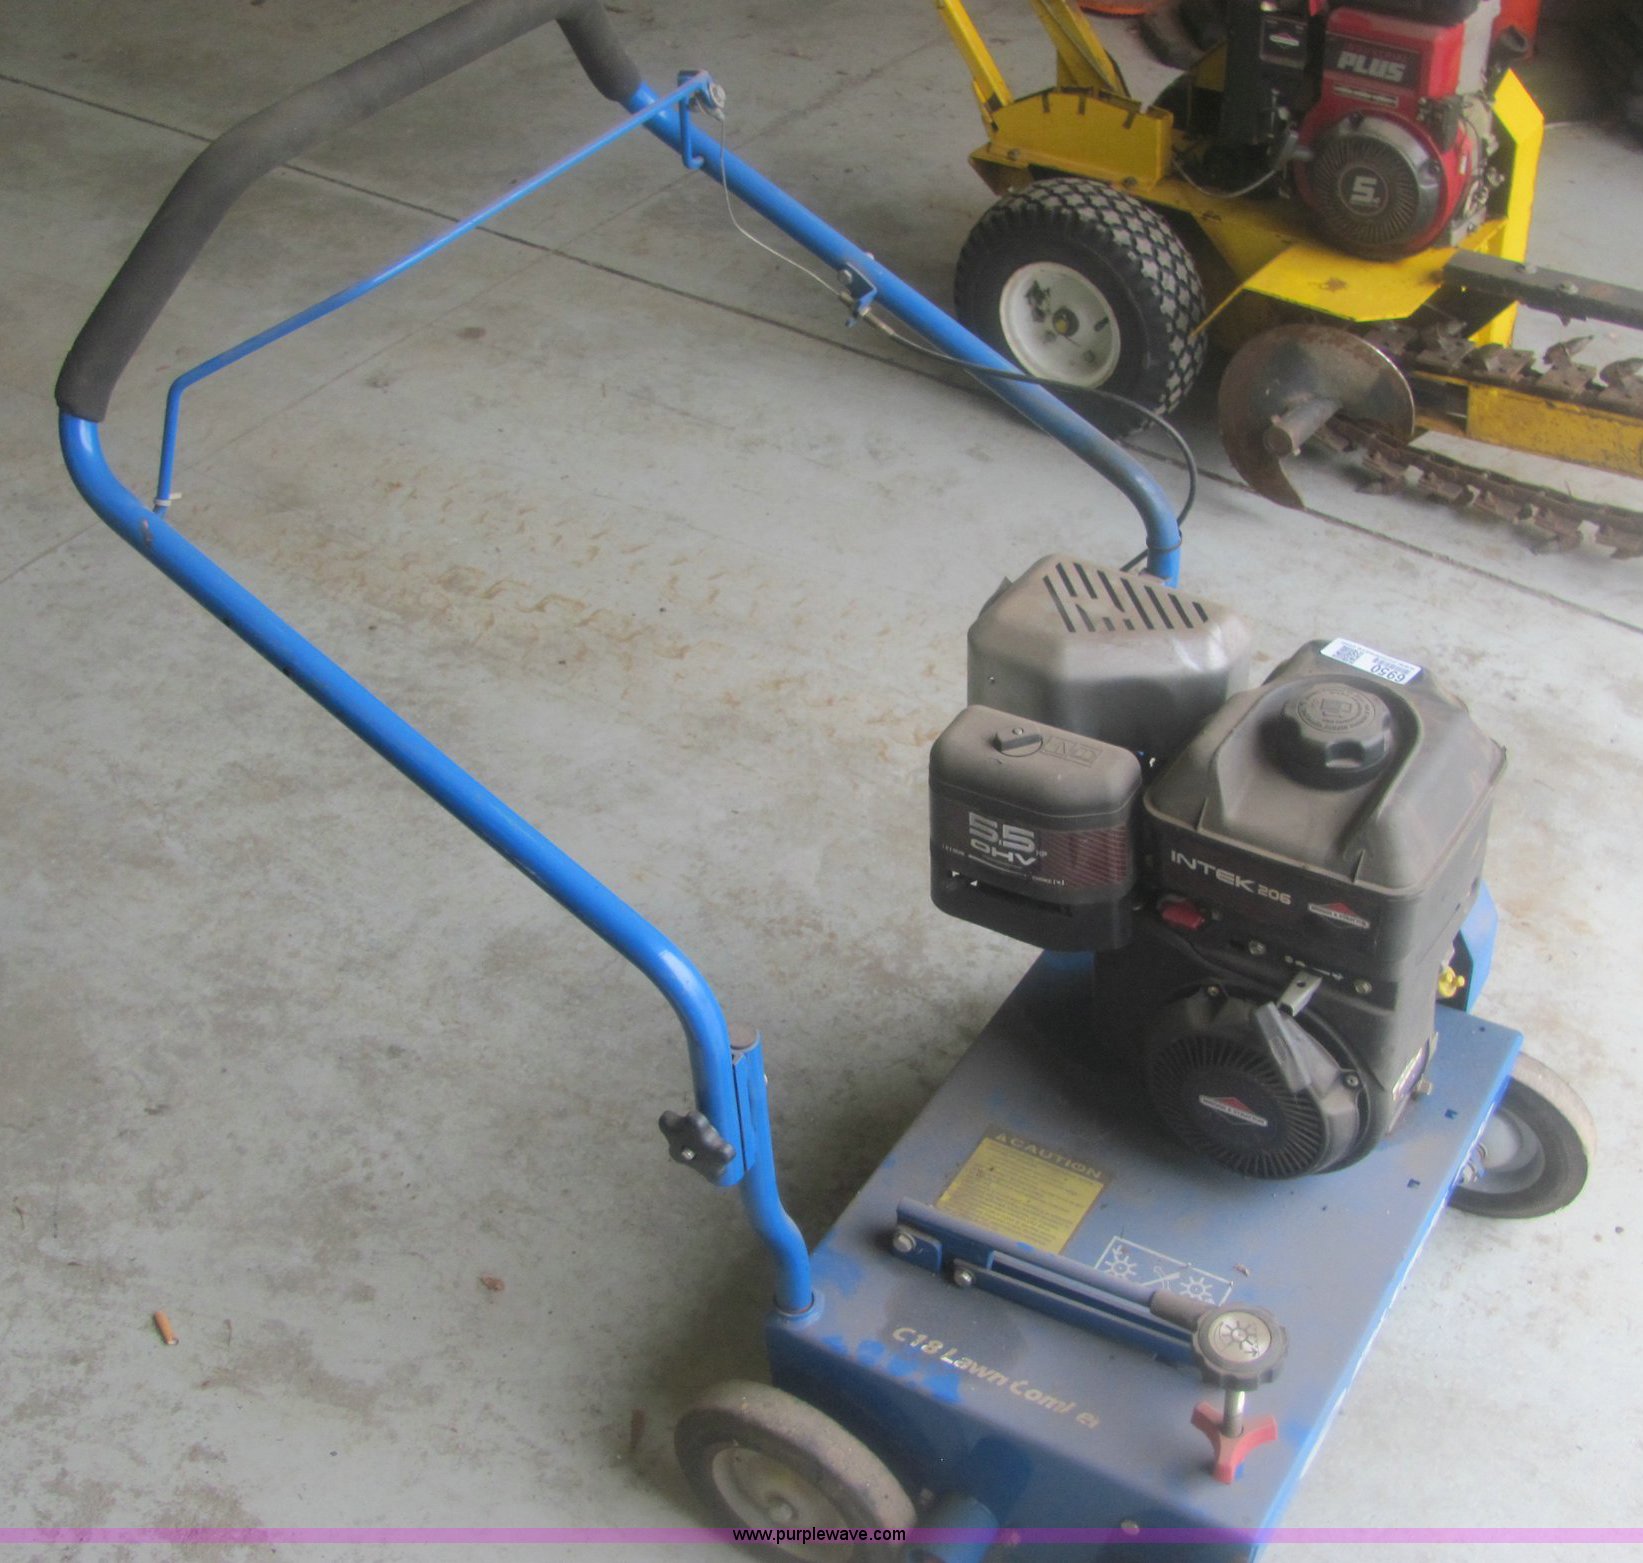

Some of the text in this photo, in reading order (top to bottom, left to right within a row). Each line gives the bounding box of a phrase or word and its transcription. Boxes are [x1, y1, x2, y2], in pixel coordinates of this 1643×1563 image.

[1336, 51, 1406, 82] PLUS
[1370, 664, 1406, 682] 6950
[968, 811, 1036, 852] 5.5
[970, 838, 1037, 866] OHV
[1171, 850, 1292, 905] INTEK 206
[1009, 1136, 1102, 1179] CAUTION
[892, 1327, 944, 1355] C18
[940, 1348, 1009, 1386] Lawn
